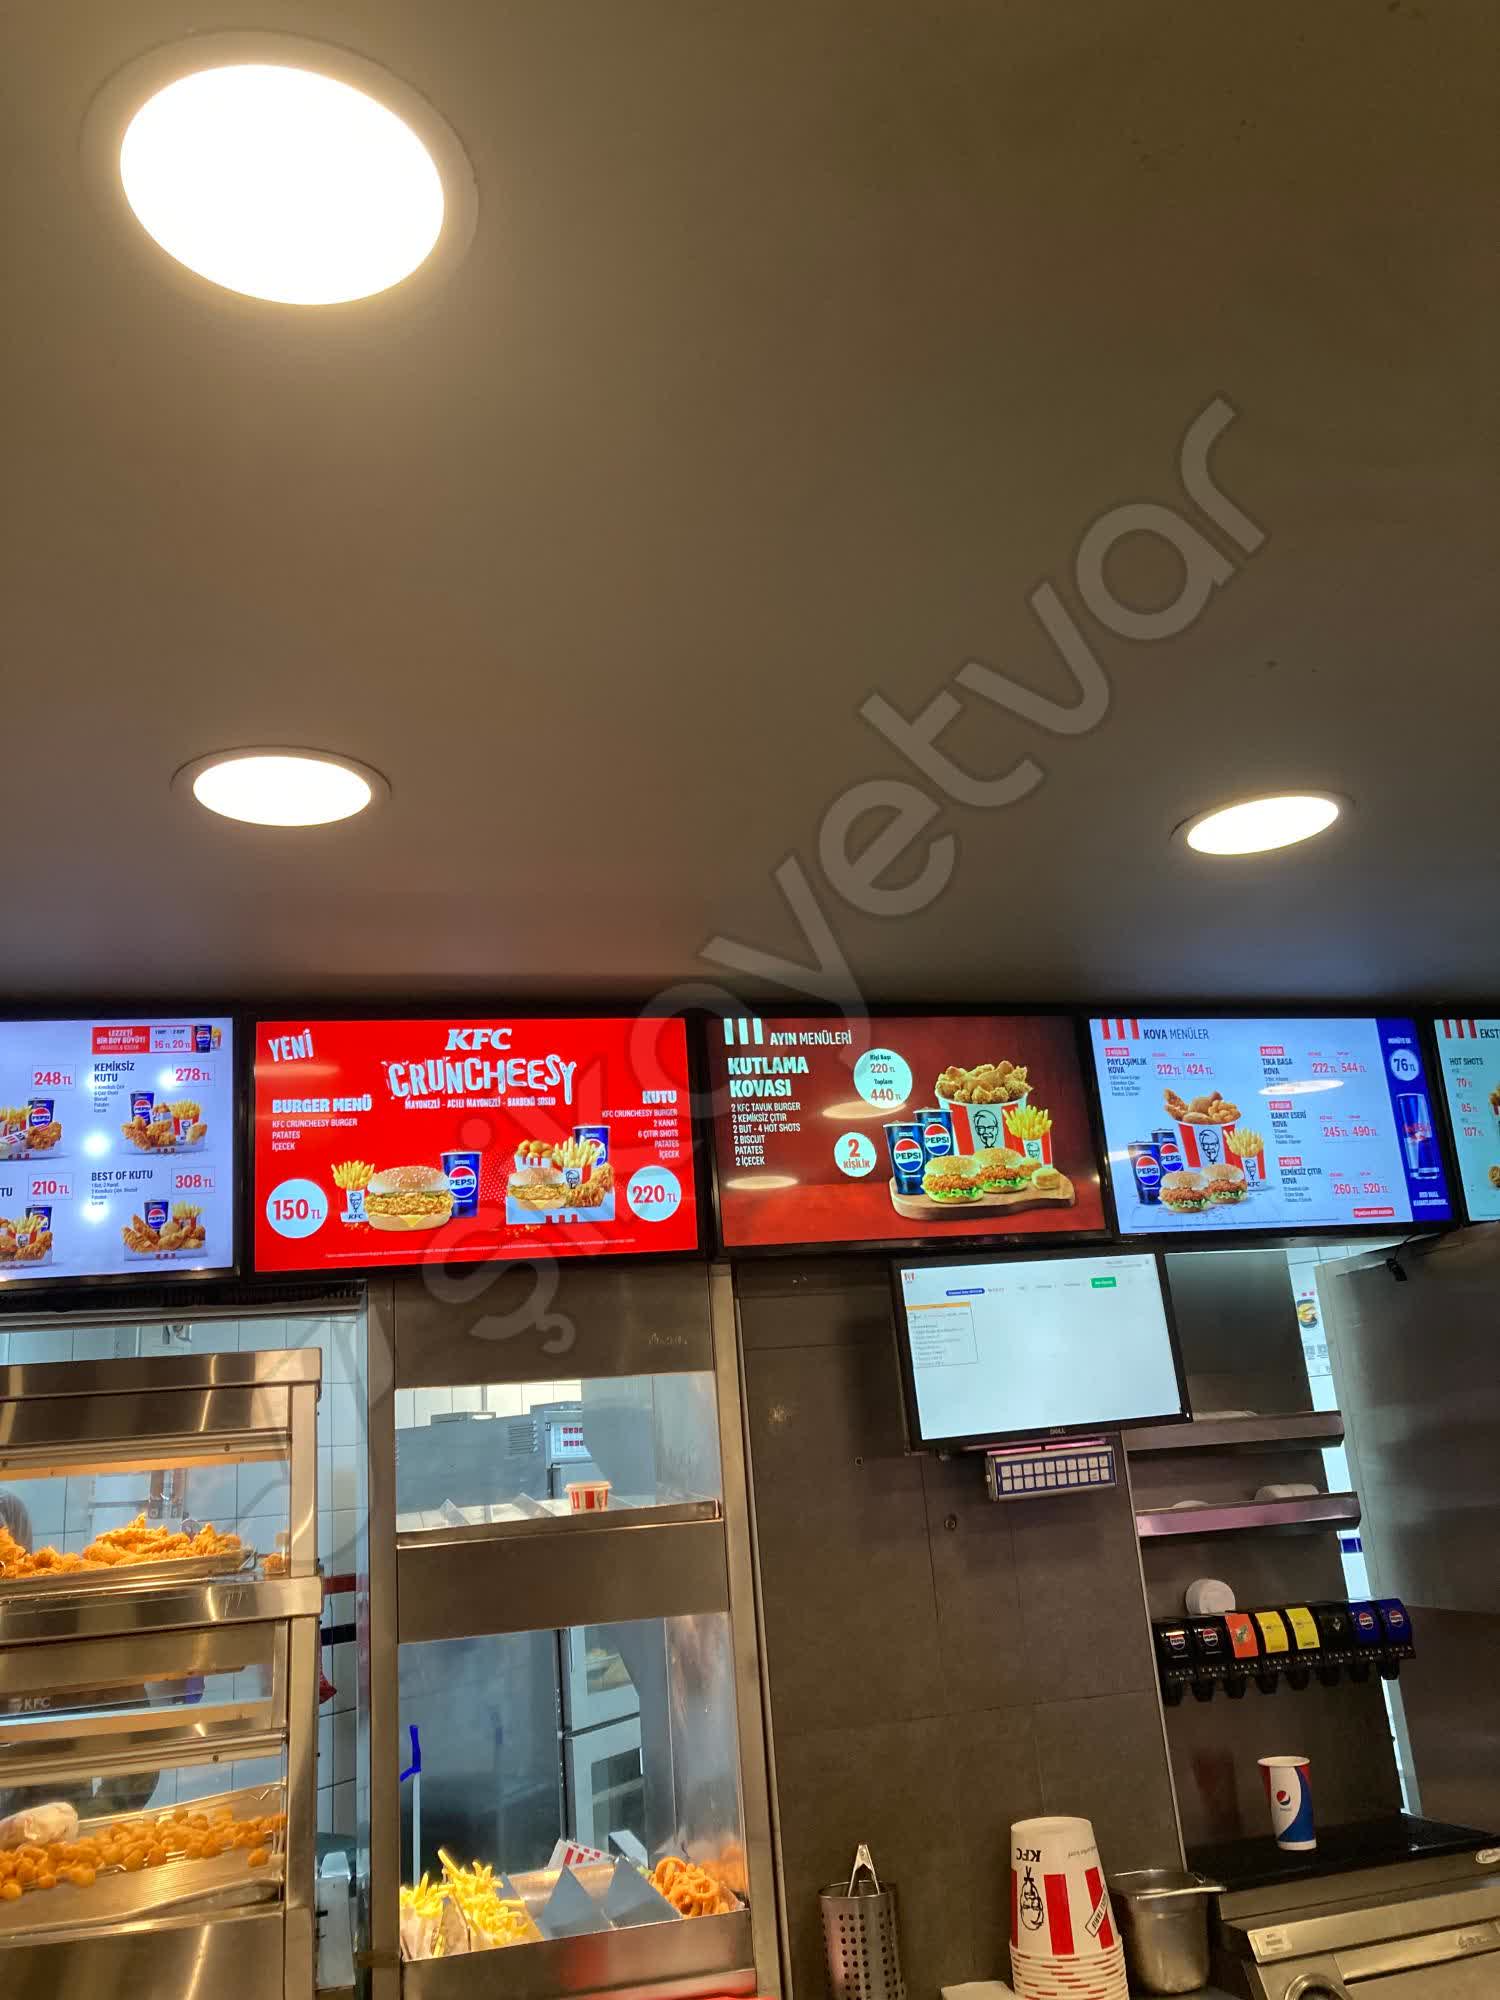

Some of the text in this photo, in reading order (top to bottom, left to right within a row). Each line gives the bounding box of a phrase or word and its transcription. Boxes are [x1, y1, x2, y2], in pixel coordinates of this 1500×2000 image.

[770, 1029, 852, 1046] AYIN MENÜLERİ
[1143, 1026, 1210, 1040] KOVA MENÜLER
[154, 1040, 163, 1049] 16
[172, 1039, 184, 1048] 20
[444, 1028, 513, 1051] KFC
[268, 1028, 315, 1063] YENİ
[94, 1060, 135, 1072] KEMİKSİZ
[727, 1056, 810, 1075] KUTLAMA
[1106, 1057, 1147, 1067] PAYLAŞIMLIK
[1262, 1057, 1293, 1066] TIKA BASA
[1393, 1058, 1416, 1072] 76 TL
[1449, 1057, 1484, 1065] HOT SHOTS
[870, 1063, 888, 1073] 220
[1108, 1066, 1126, 1074] KOVA
[1157, 1064, 1174, 1075] 212
[1186, 1063, 1204, 1075] 424
[1263, 1067, 1280, 1075] KOVA
[1341, 1062, 1358, 1073] 544
[34, 1071, 72, 1086] 248 TL
[94, 1073, 118, 1082] KUTU
[175, 1067, 212, 1082] 278 TL
[387, 1054, 577, 1105] CRUNCHEESY
[729, 1078, 792, 1098] KOVASI
[642, 1089, 678, 1105] KUTU
[871, 1088, 894, 1101] 440
[271, 1093, 373, 1114] BURGER MENÜ
[730, 1101, 801, 1112] 2 KFC TAVUK BURGER
[1461, 1103, 1472, 1113] 85
[614, 1109, 653, 1118] CRUNCHEESY
[731, 1112, 787, 1123] 2 KEMİKSİZ ÇITIR
[1271, 1111, 1290, 1120] KANAT
[272, 1118, 358, 1128] KFC CRUNCHEESY BURGER
[653, 1119, 678, 1127] 2 KANAT
[732, 1124, 738, 1134] 2
[738, 1124, 752, 1134] BUT
[757, 1123, 763, 1132] 4
[763, 1123, 777, 1133] HOT
[778, 1122, 801, 1132] SHOTS
[1272, 1120, 1288, 1128] KOVA
[271, 1130, 301, 1140] PATATES
[659, 1129, 679, 1138] SHOTS
[1323, 1126, 1340, 1137] 245
[1352, 1126, 1370, 1137] 490
[1463, 1126, 1477, 1137] 107
[654, 1139, 680, 1149] PATATES
[733, 1134, 766, 1145] 2 BISCUIT
[925, 1136, 950, 1144] PEPSI
[271, 1141, 296, 1153] İÇECEK
[734, 1145, 764, 1155] PATATES
[848, 1138, 861, 1158] 2
[735, 1155, 765, 1167] 2 İÇECEK
[896, 1152, 922, 1160] PEPSI
[843, 1157, 870, 1170] KİŞİLİK
[91, 1169, 153, 1181] BEST OF KUTU
[1280, 1166, 1306, 1176] KEMİKSİZ
[175, 1174, 214, 1189] 308 TL
[1281, 1177, 1298, 1185] KOVA
[31, 1180, 70, 1195] 210 TL
[1333, 1184, 1351, 1195] 260
[1363, 1183, 1380, 1194] 520
[632, 1184, 678, 1204] 220 TL
[272, 1199, 322, 1221] 150 TL
[1016, 1847, 1042, 1862] KFC
